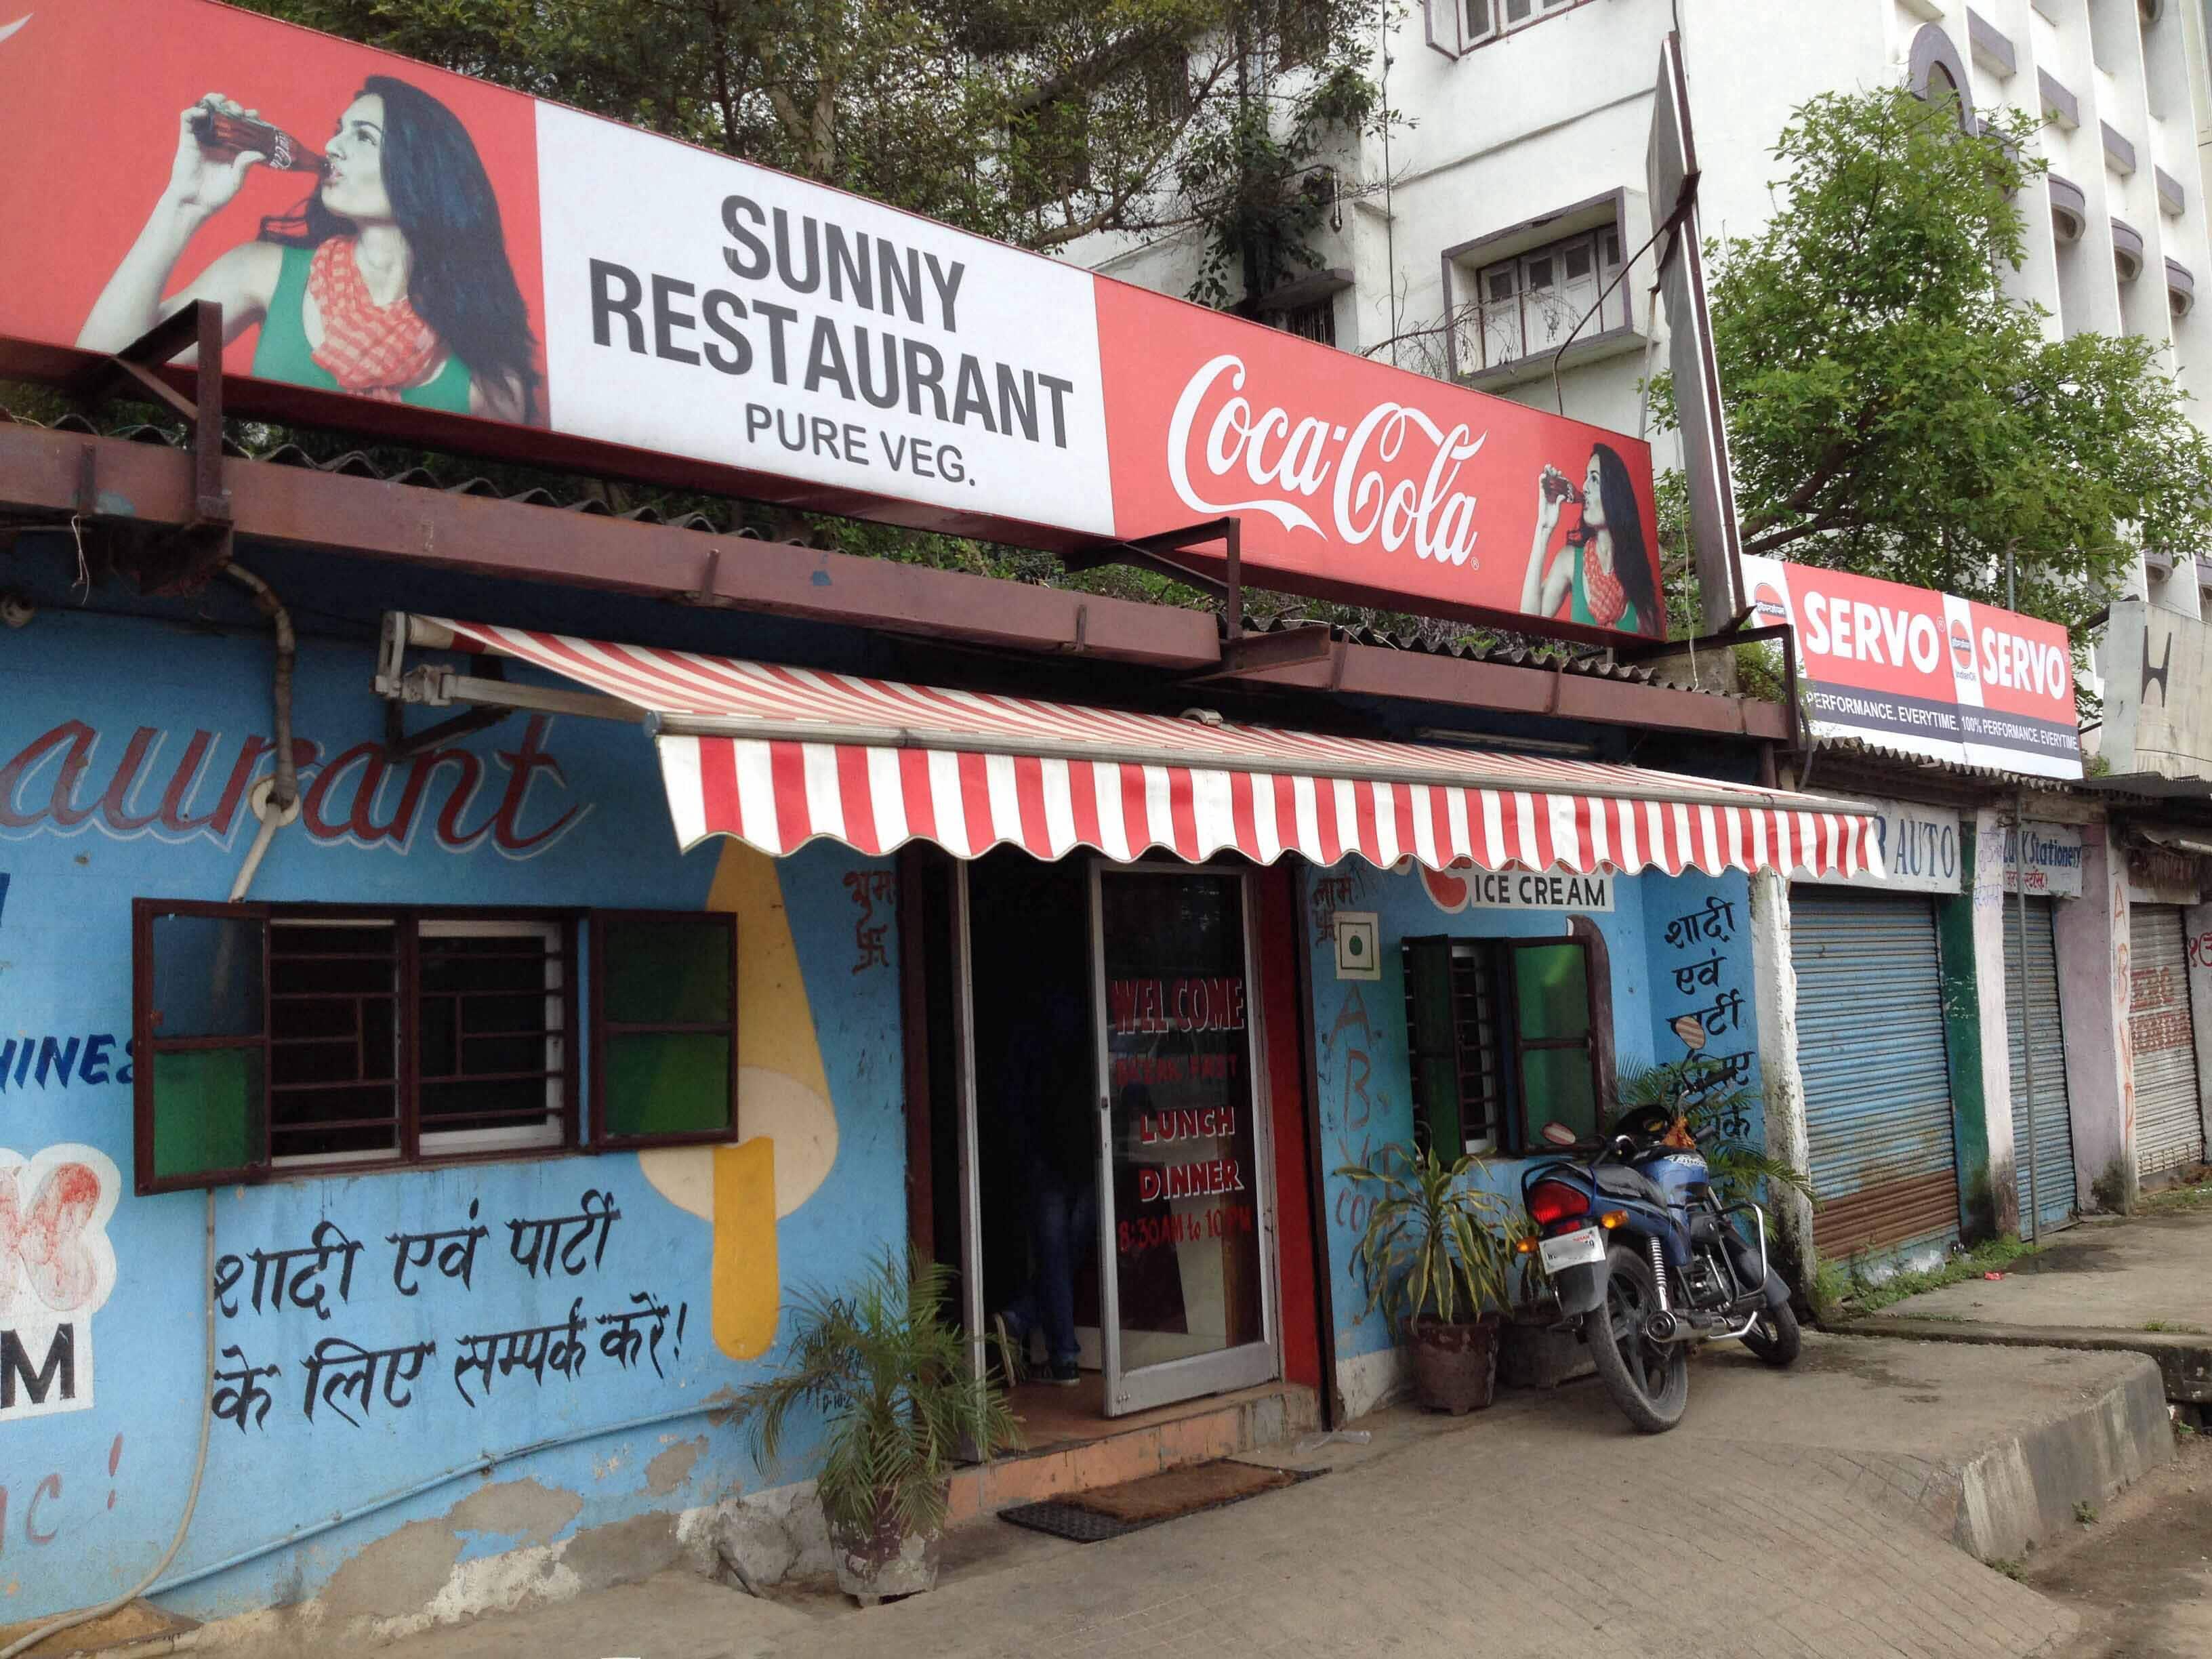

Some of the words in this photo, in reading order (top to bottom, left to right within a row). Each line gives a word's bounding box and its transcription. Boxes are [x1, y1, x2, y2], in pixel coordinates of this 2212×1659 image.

[720, 194, 966, 333] SUNNY
[590, 258, 1073, 449] RESTAURANT
[746, 403, 870, 466] PURE
[880, 429, 977, 487] VEG.
[1167, 355, 1488, 566] Coca-Cola
[1803, 591, 1940, 674] SERVO
[1981, 627, 2066, 701] SERVO
[2141, 625, 2172, 708] H
[1805, 691, 1897, 721] PERFORMANCE.
[1898, 705, 1960, 731] EVERYTIME.
[1961, 715, 1982, 734] 100%
[1982, 718, 2041, 743] PERFORMANCE.
[1894, 819, 1954, 878] AUTO
[1474, 874, 1511, 903] ICE
[1518, 876, 1605, 907] CREAM
[1664, 896, 1735, 949] शादी
[1671, 947, 1727, 995] एवं
[1140, 1106, 1236, 1144] LUNCH
[1139, 1159, 1245, 1202] DINNER
[213, 1220, 365, 1320] शादी
[385, 1197, 490, 1296] एवं
[504, 1189, 621, 1279] पार्टी
[1187, 1212, 1202, 1242] to
[211, 1344, 283, 1435] के
[299, 1337, 436, 1428] लिए
[455, 1296, 588, 1408] सम्पर्क
